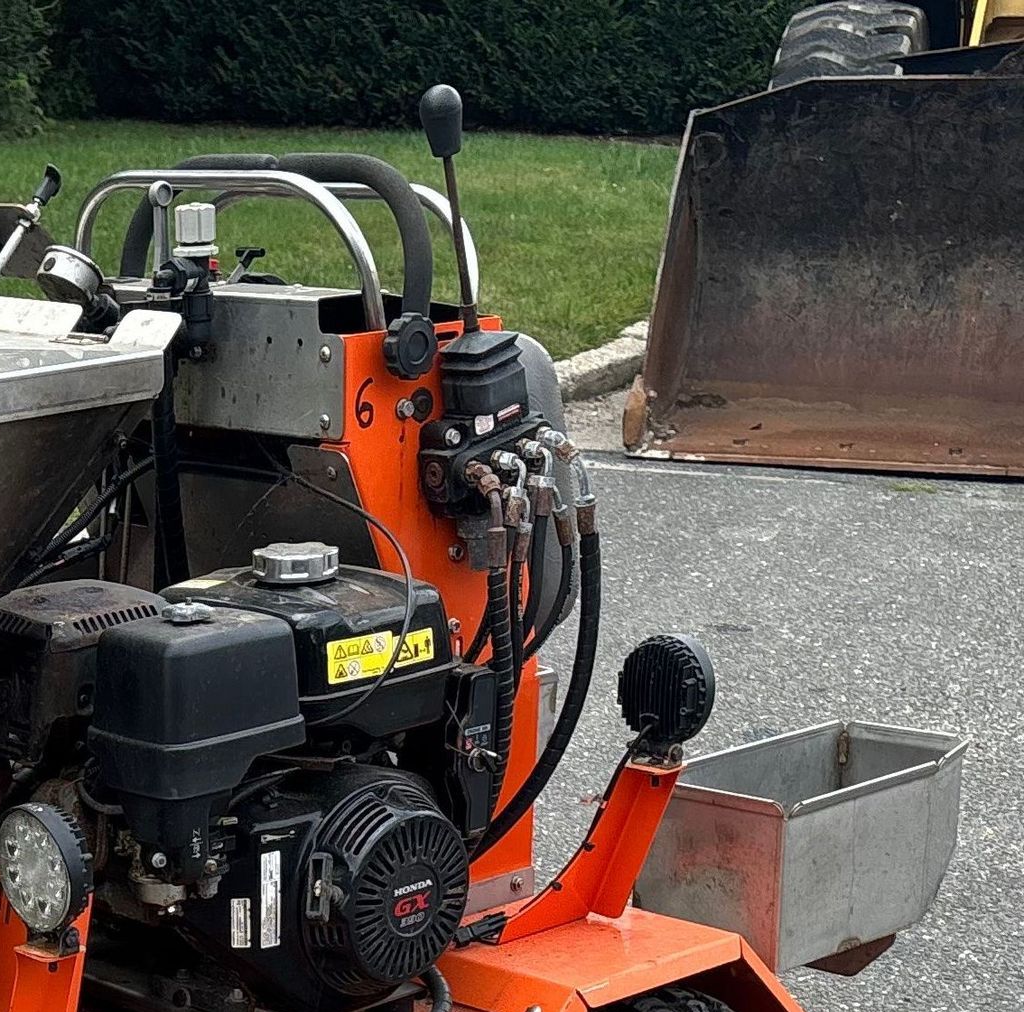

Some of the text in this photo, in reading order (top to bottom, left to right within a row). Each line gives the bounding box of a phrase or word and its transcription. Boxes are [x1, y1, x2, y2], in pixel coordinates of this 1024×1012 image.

[355, 376, 374, 429] 6
[394, 879, 433, 897] HONDA
[394, 890, 432, 917] GX
